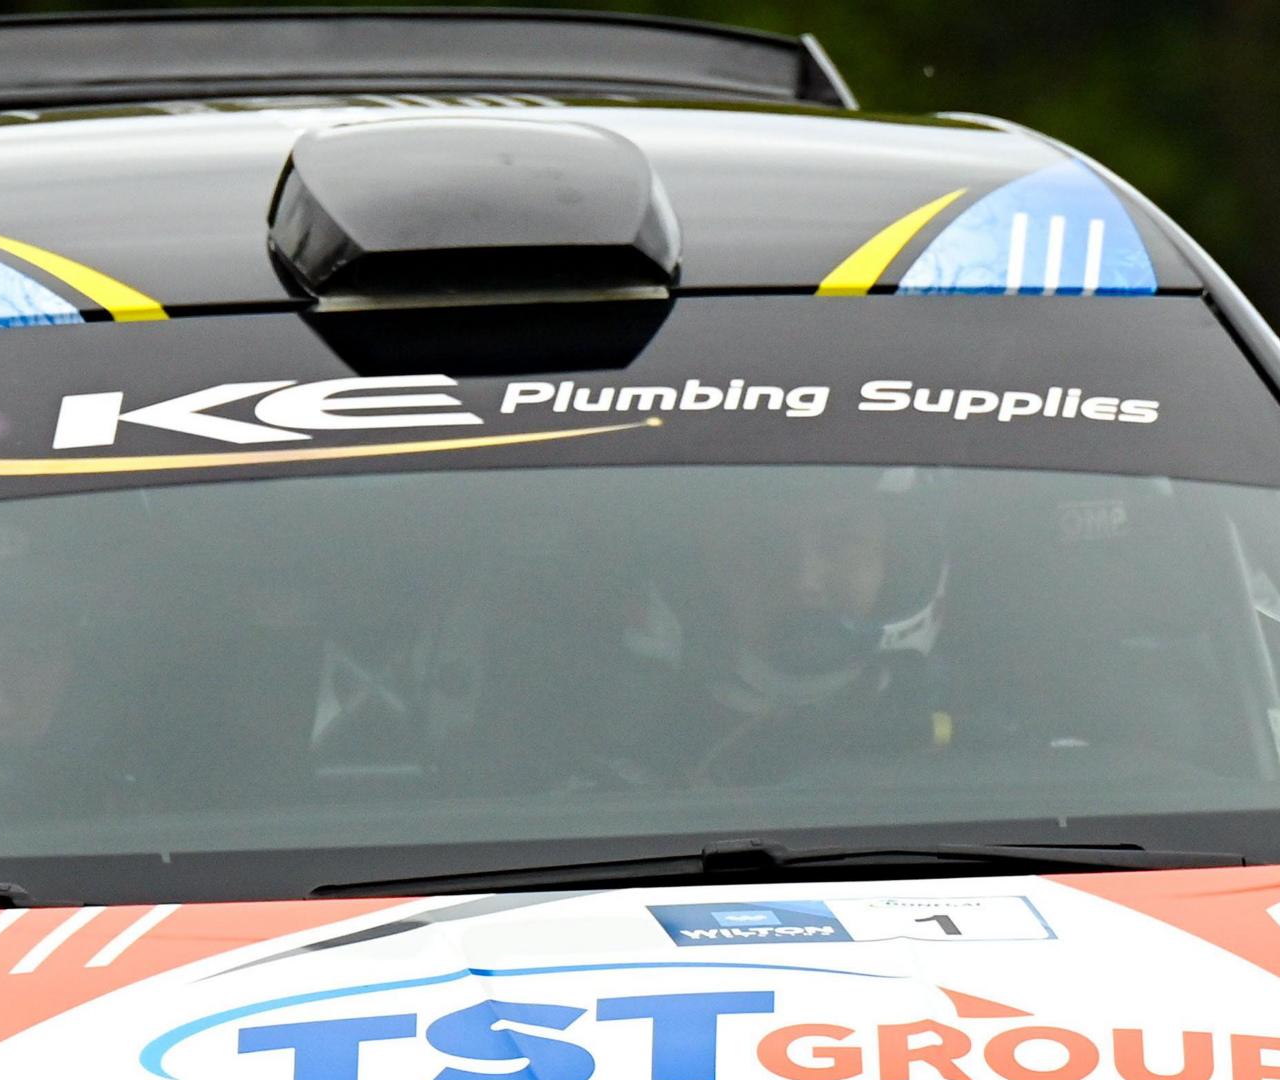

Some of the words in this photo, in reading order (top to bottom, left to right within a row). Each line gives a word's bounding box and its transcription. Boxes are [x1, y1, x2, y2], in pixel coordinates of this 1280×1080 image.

[52, 373, 484, 450] KE
[500, 379, 830, 418] Plumbing
[858, 379, 1160, 423] Supplies
[914, 914, 963, 936] 1
